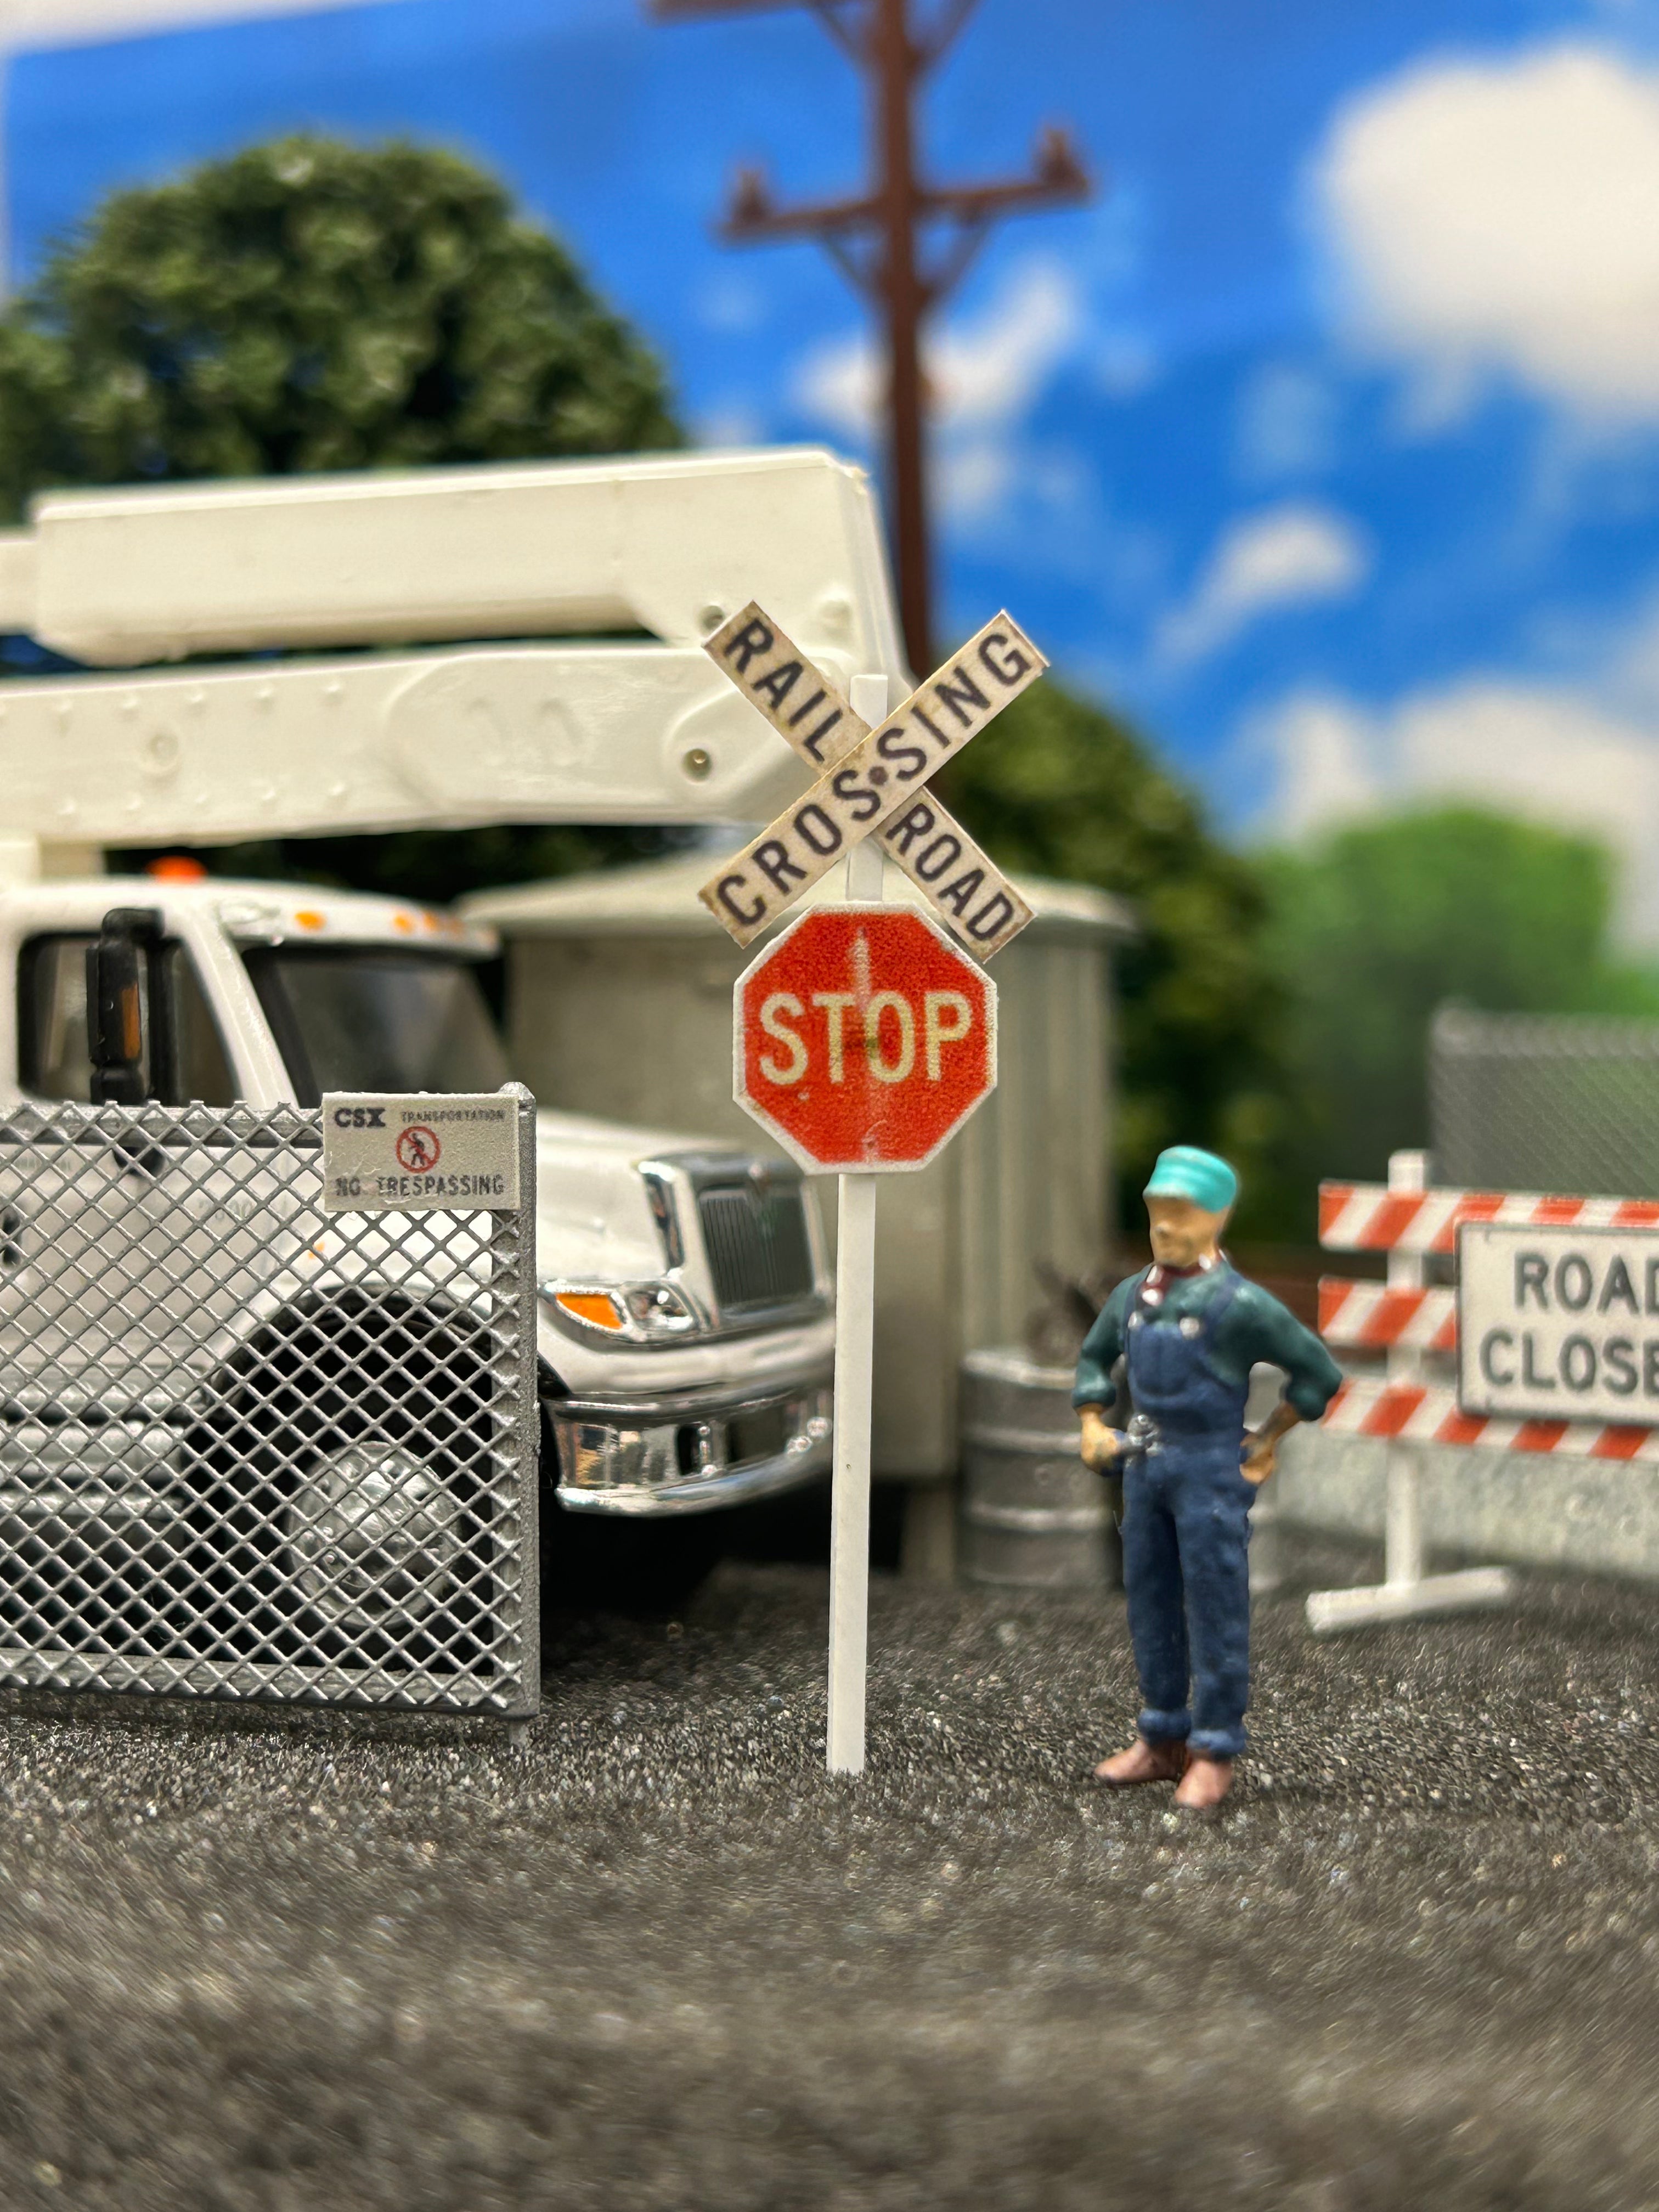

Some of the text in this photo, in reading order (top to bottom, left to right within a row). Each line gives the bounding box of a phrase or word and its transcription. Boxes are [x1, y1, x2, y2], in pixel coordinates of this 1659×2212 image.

[716, 634, 1032, 926] CROSSING
[725, 618, 1013, 940] RAIL ROAD
[760, 991, 973, 1085] STOP
[334, 1107, 386, 1128] CSX
[336, 1175, 504, 1197] NO TRESPASSING
